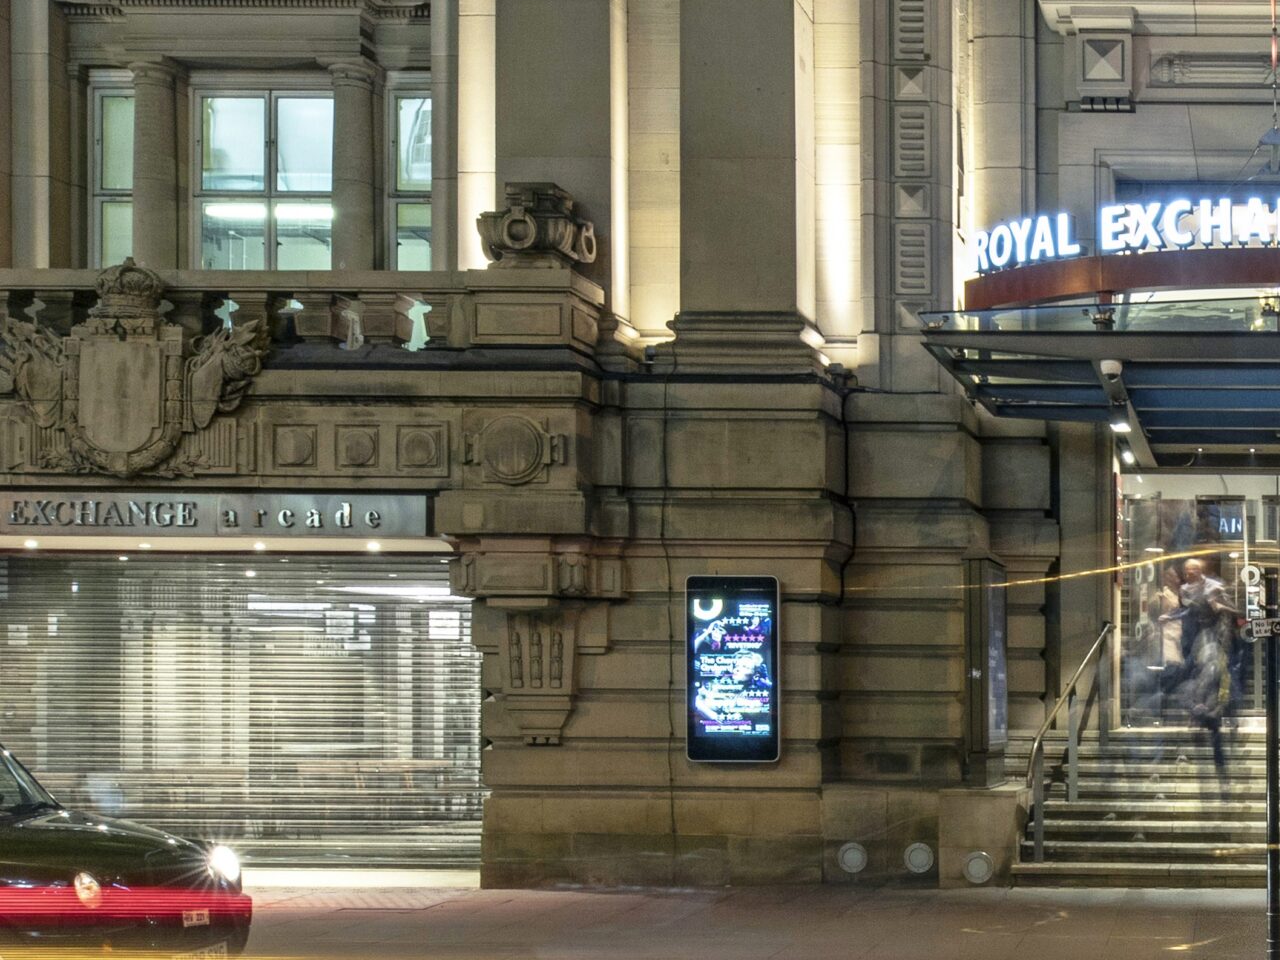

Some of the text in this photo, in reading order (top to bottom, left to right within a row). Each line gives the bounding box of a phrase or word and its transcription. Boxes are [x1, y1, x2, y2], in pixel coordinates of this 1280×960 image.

[975, 212, 1080, 271] ROYAL
[8, 499, 381, 528] EXCHANGE arcade
